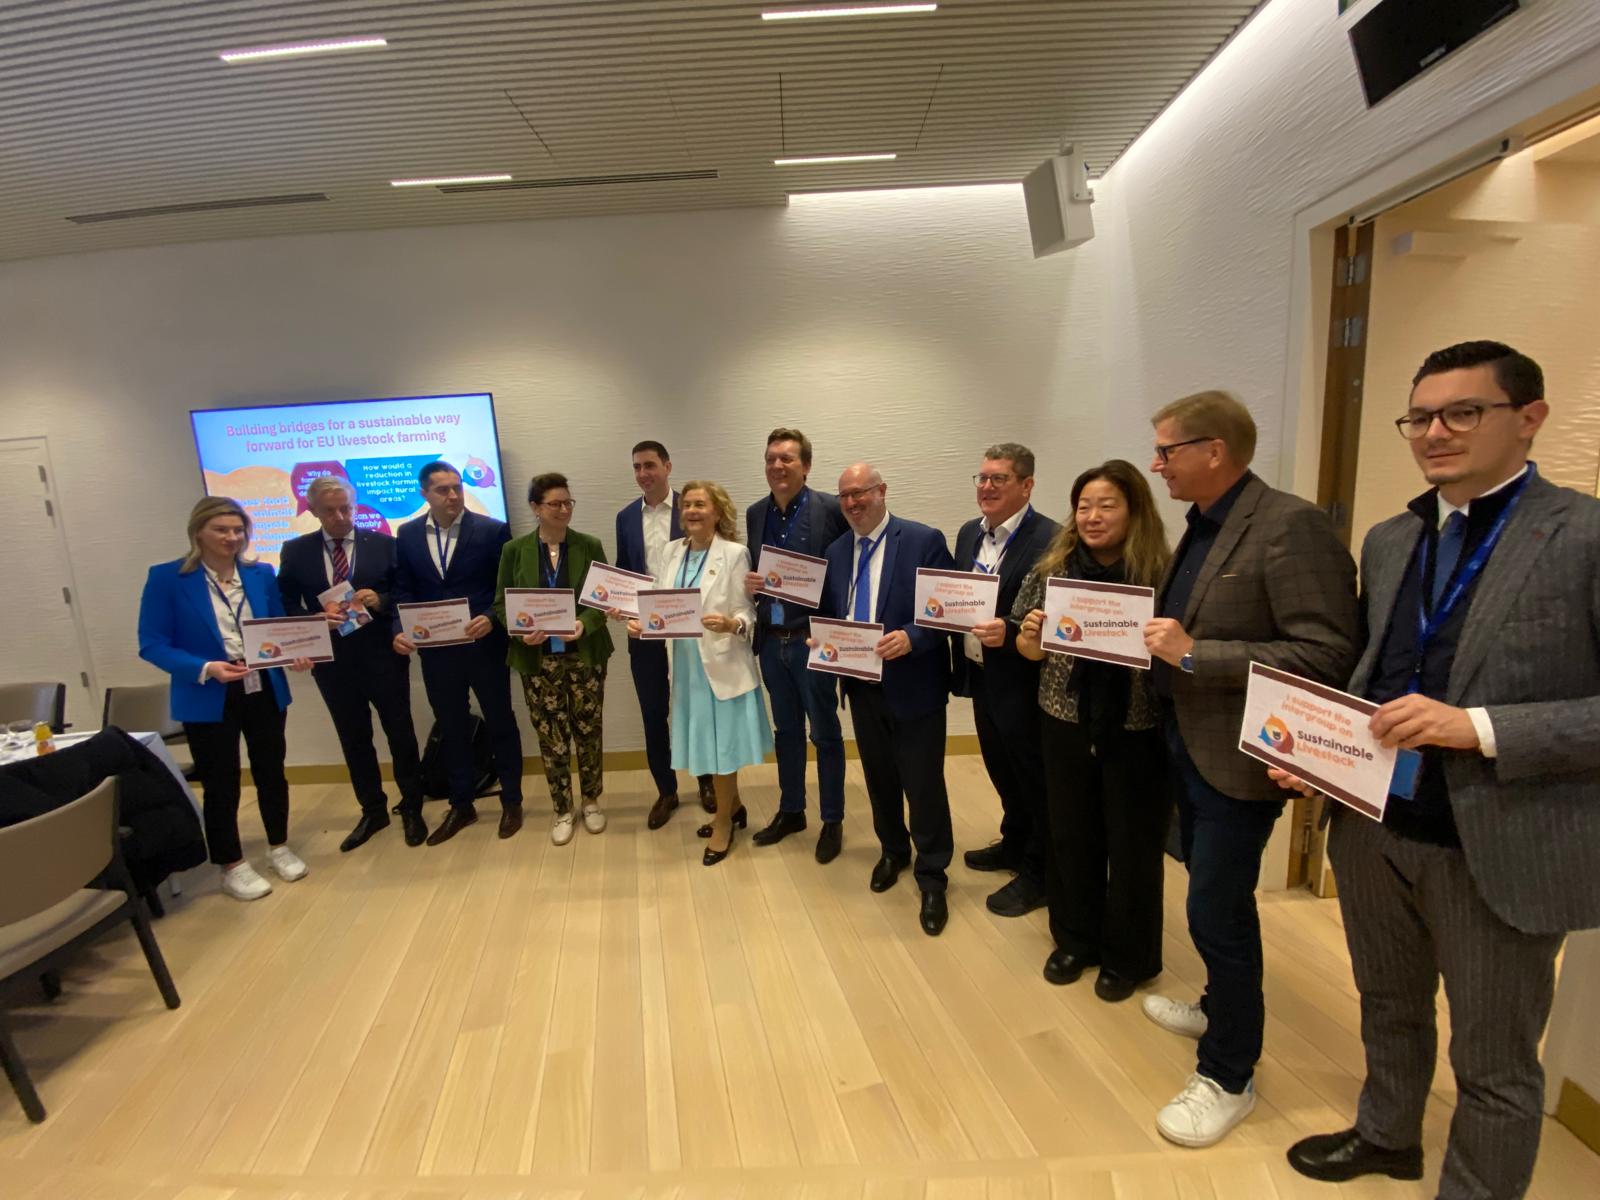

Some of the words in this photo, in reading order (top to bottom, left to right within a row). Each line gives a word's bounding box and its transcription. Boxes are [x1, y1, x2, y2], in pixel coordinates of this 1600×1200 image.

[226, 422, 277, 437] Building
[279, 420, 325, 435] bridges
[328, 418, 345, 431] for
[348, 420, 356, 429] a
[358, 413, 432, 429] sustainable
[434, 414, 460, 426] way
[245, 439, 294, 453] forward
[297, 437, 314, 449] for
[317, 435, 335, 448] EU
[338, 432, 395, 446] livestock
[397, 429, 447, 443] farming
[381, 462, 405, 470] would
[365, 471, 403, 479] reduction
[356, 479, 390, 488] livestock
[392, 478, 419, 486] farmin
[944, 599, 986, 608] Sustainable
[1083, 619, 1139, 628] Sustainable
[1291, 696, 1332, 717] support
[1335, 711, 1351, 726] the
[1339, 727, 1353, 738] on
[1297, 730, 1374, 761] Sustainable
[1296, 741, 1355, 769] Livestock
